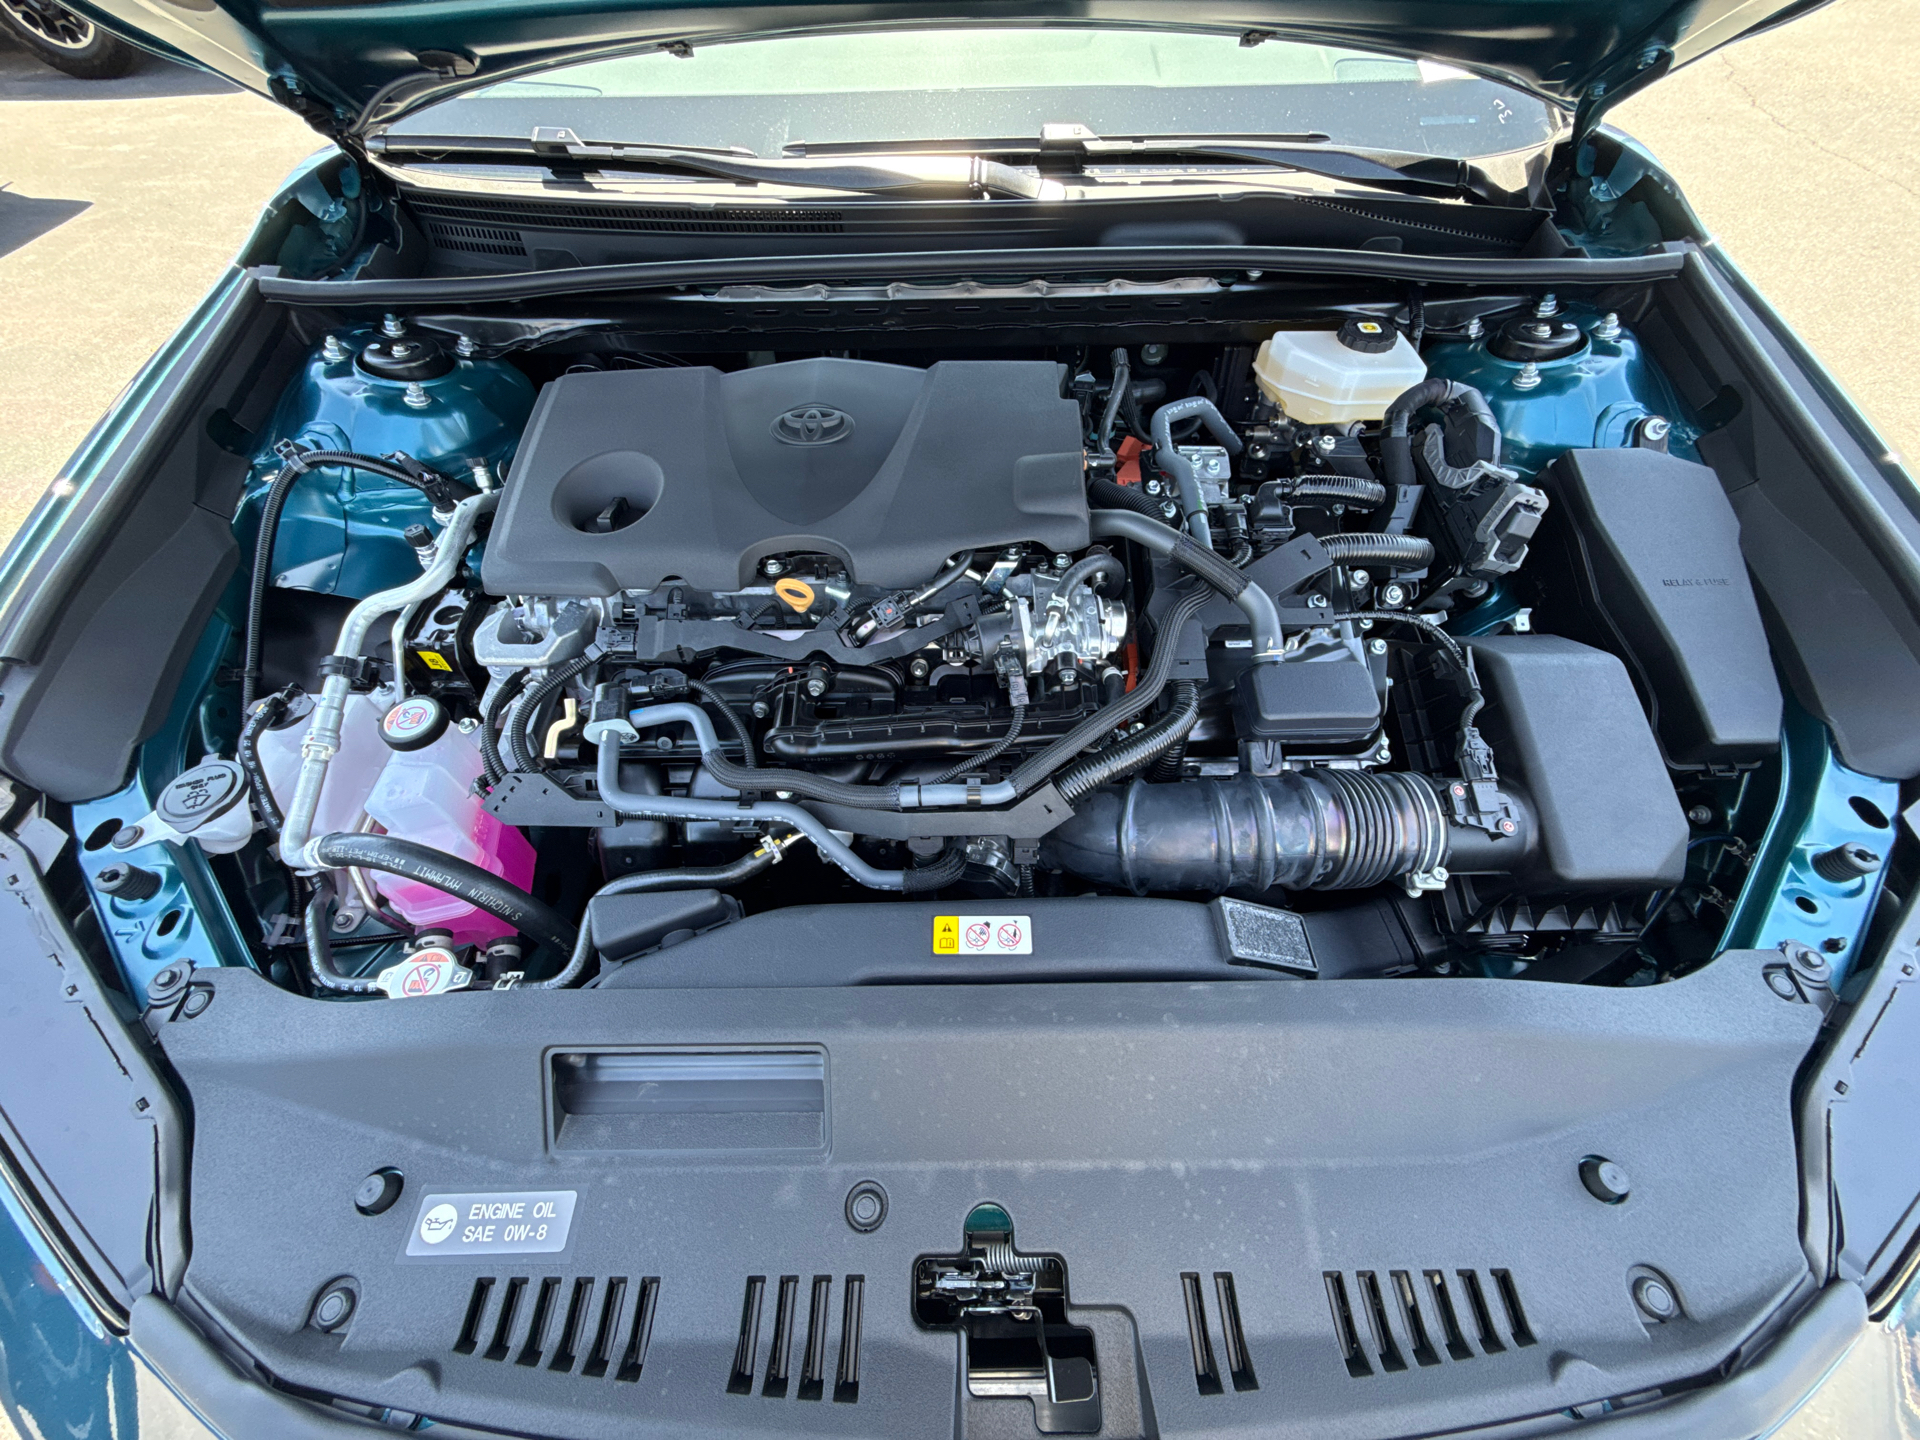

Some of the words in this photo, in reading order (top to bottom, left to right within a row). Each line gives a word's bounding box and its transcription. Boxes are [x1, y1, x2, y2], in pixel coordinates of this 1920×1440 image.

[1662, 578, 1694, 587] RELAY
[1703, 578, 1731, 586] FUSE
[206, 773, 227, 782] FLUID
[413, 865, 463, 891] HYLAMMIT
[468, 1202, 526, 1220] ENGINE
[532, 1202, 557, 1218] OIL
[462, 1225, 496, 1243] SAE
[503, 1224, 548, 1242] 0W-8
